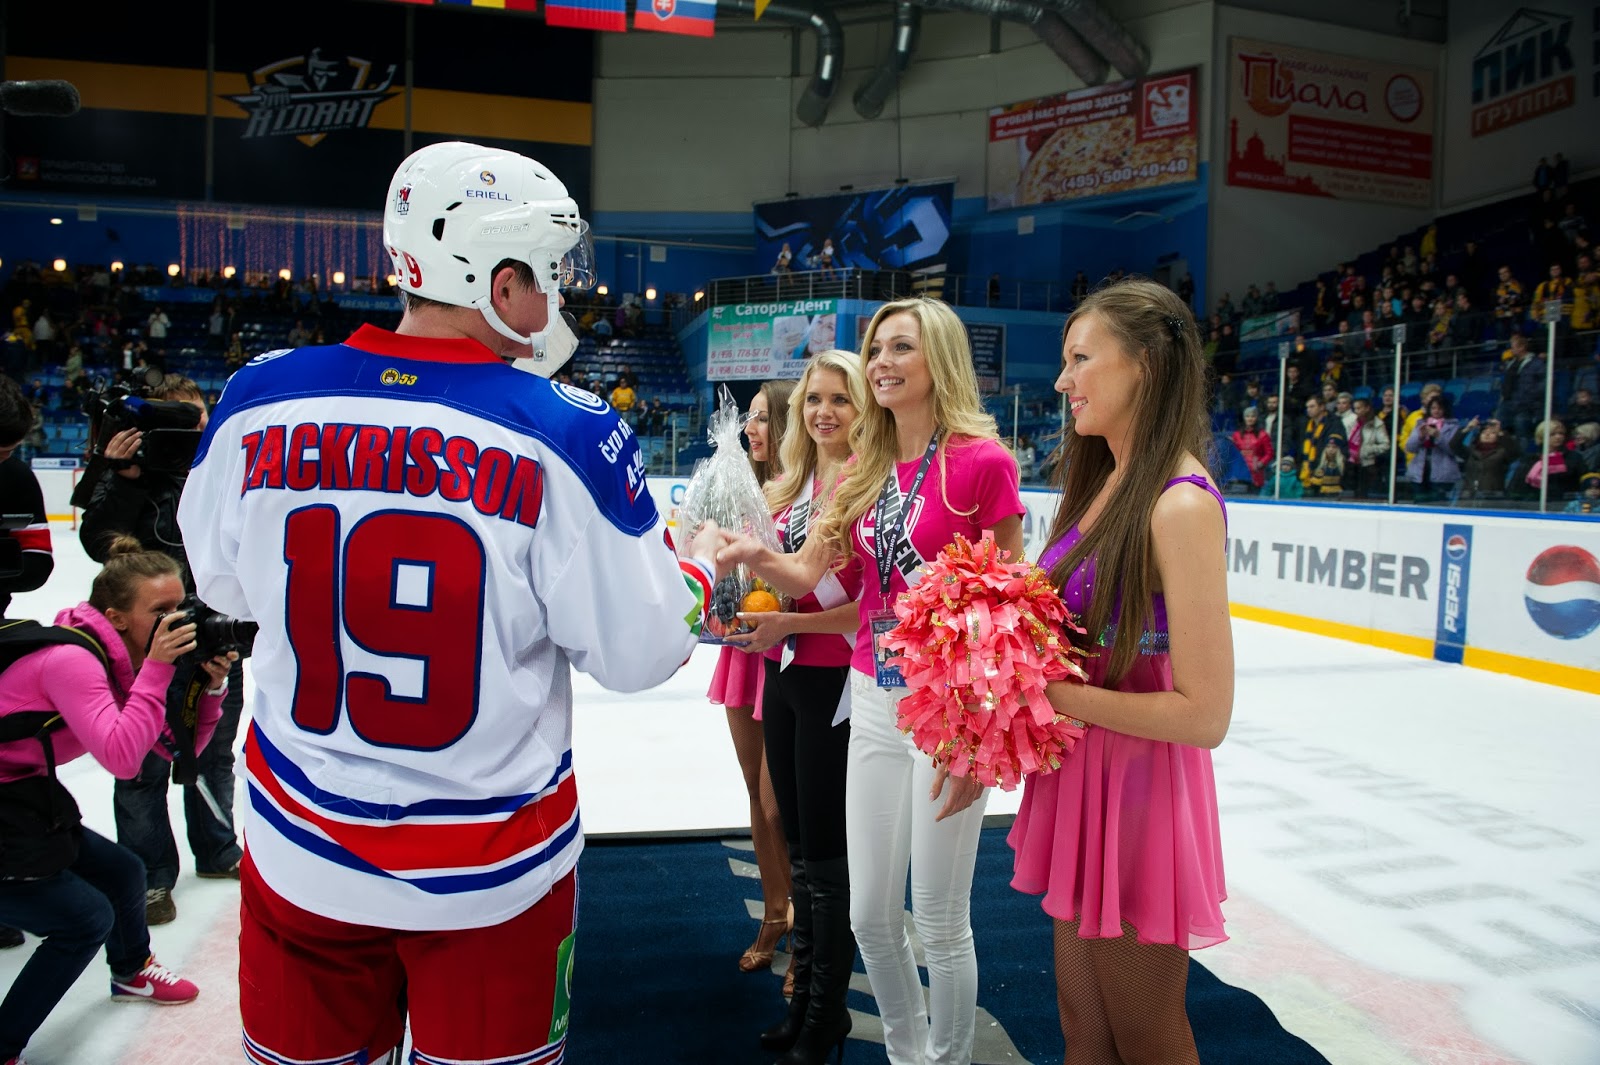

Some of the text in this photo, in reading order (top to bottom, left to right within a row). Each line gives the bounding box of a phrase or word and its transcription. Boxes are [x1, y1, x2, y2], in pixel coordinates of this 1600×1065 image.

[1238, 54, 1367, 112] Пиала
[1472, 21, 1574, 104] ПИК
[1474, 80, 1569, 131] ГРУППА
[466, 189, 513, 202] ERIELL
[1062, 173, 1101, 192] (495)
[480, 223, 531, 236] BAUER
[735, 300, 832, 316] Сатори-Дент
[398, 374, 418, 386] 53
[240, 422, 544, 529] ZACKRISSON
[1272, 542, 1430, 601] TIMBER
[1444, 562, 1462, 634] PEPSI
[284, 503, 486, 752] 19
[882, 676, 901, 685] 2345
